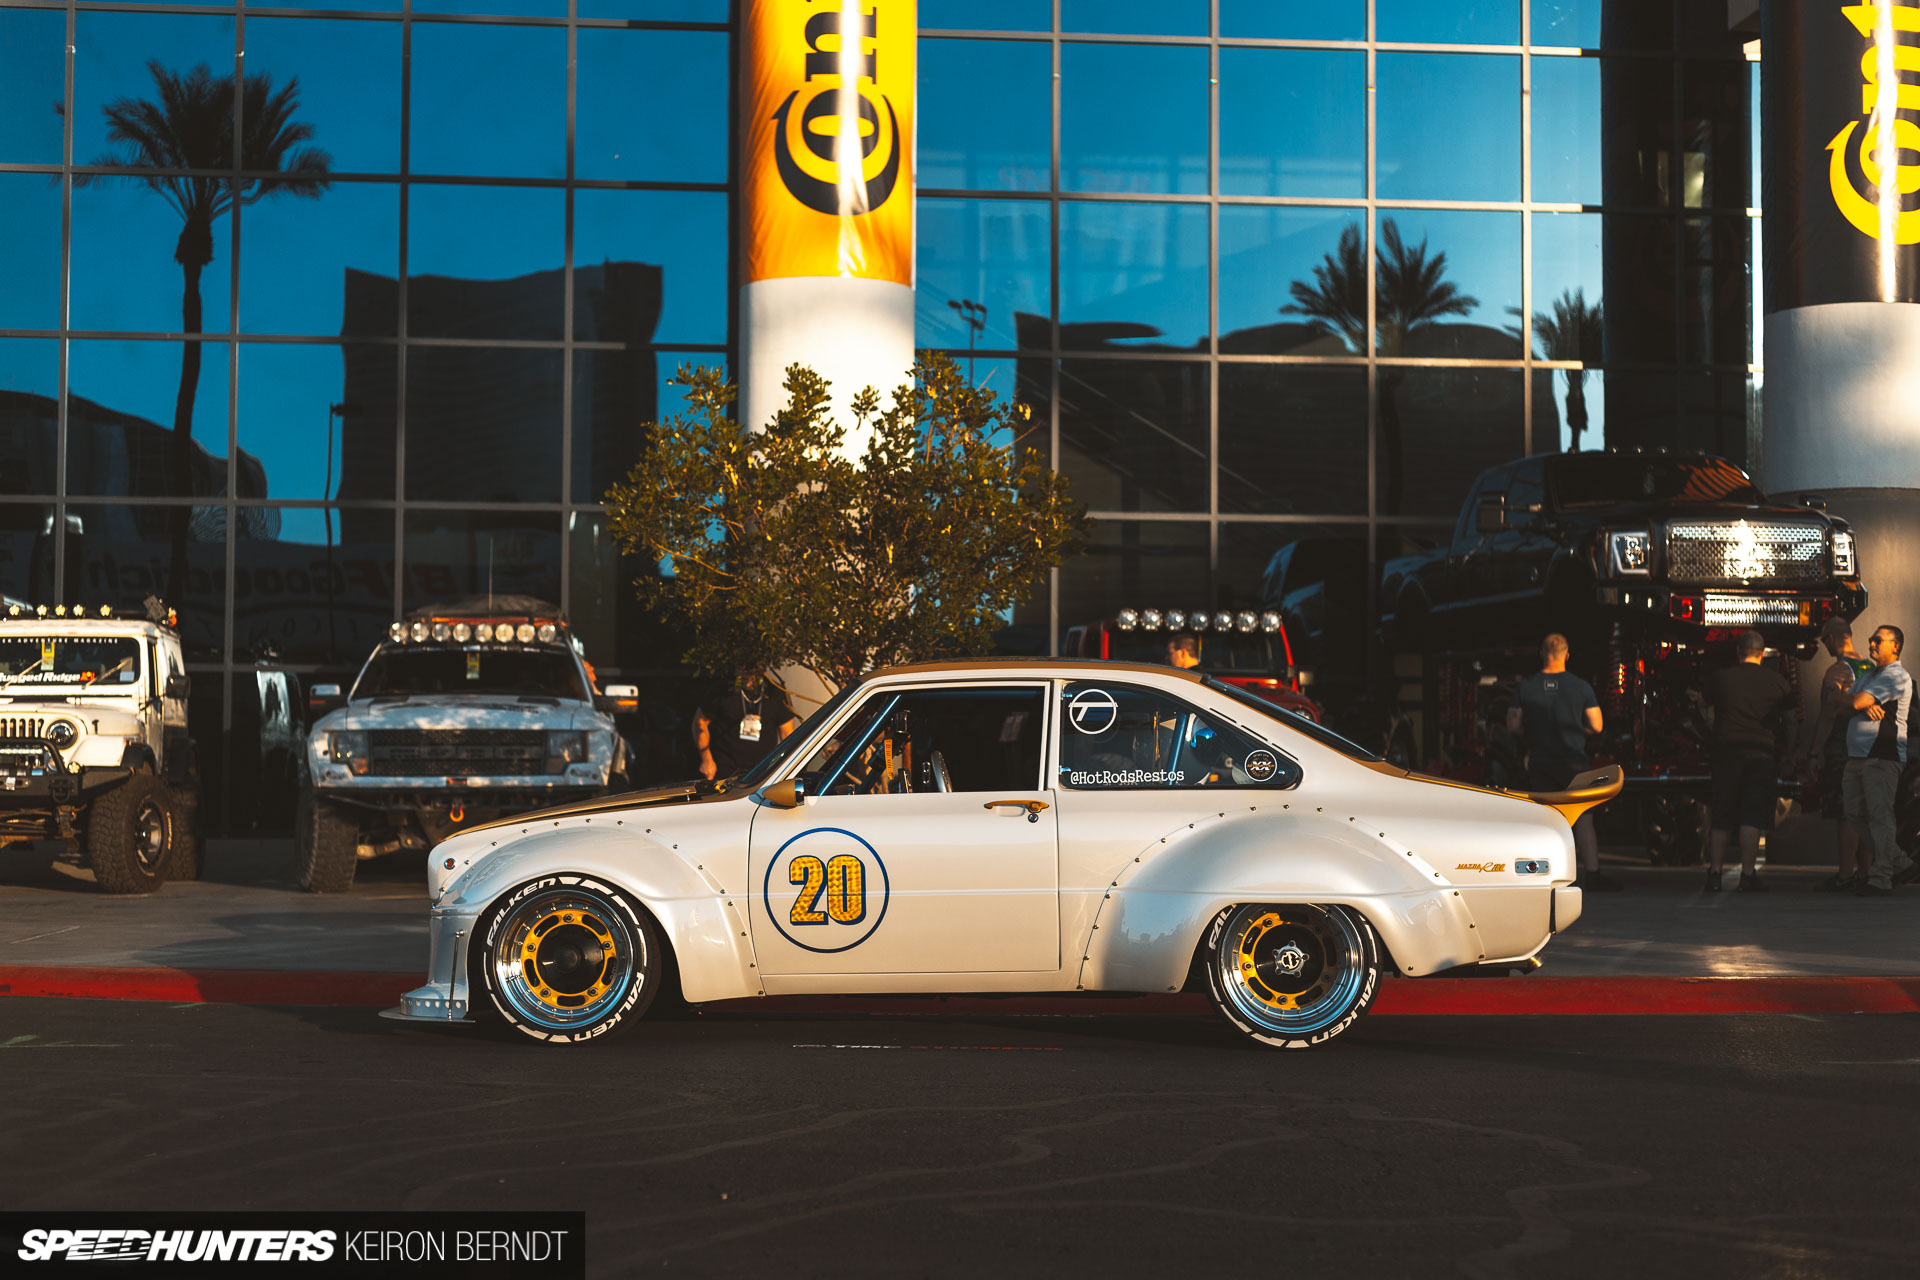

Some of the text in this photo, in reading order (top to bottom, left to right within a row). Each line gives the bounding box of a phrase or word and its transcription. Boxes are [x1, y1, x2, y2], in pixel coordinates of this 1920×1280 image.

[770, 0, 901, 217] Con
[43, 671, 80, 683] Ridge
[1070, 769, 1185, 786] @HotRodsRestos
[486, 876, 557, 947] FALKEN
[789, 854, 867, 926] 20
[1208, 903, 1237, 950] FAL
[574, 971, 645, 1042] FALKEN
[1311, 967, 1377, 1044] FALKEN
